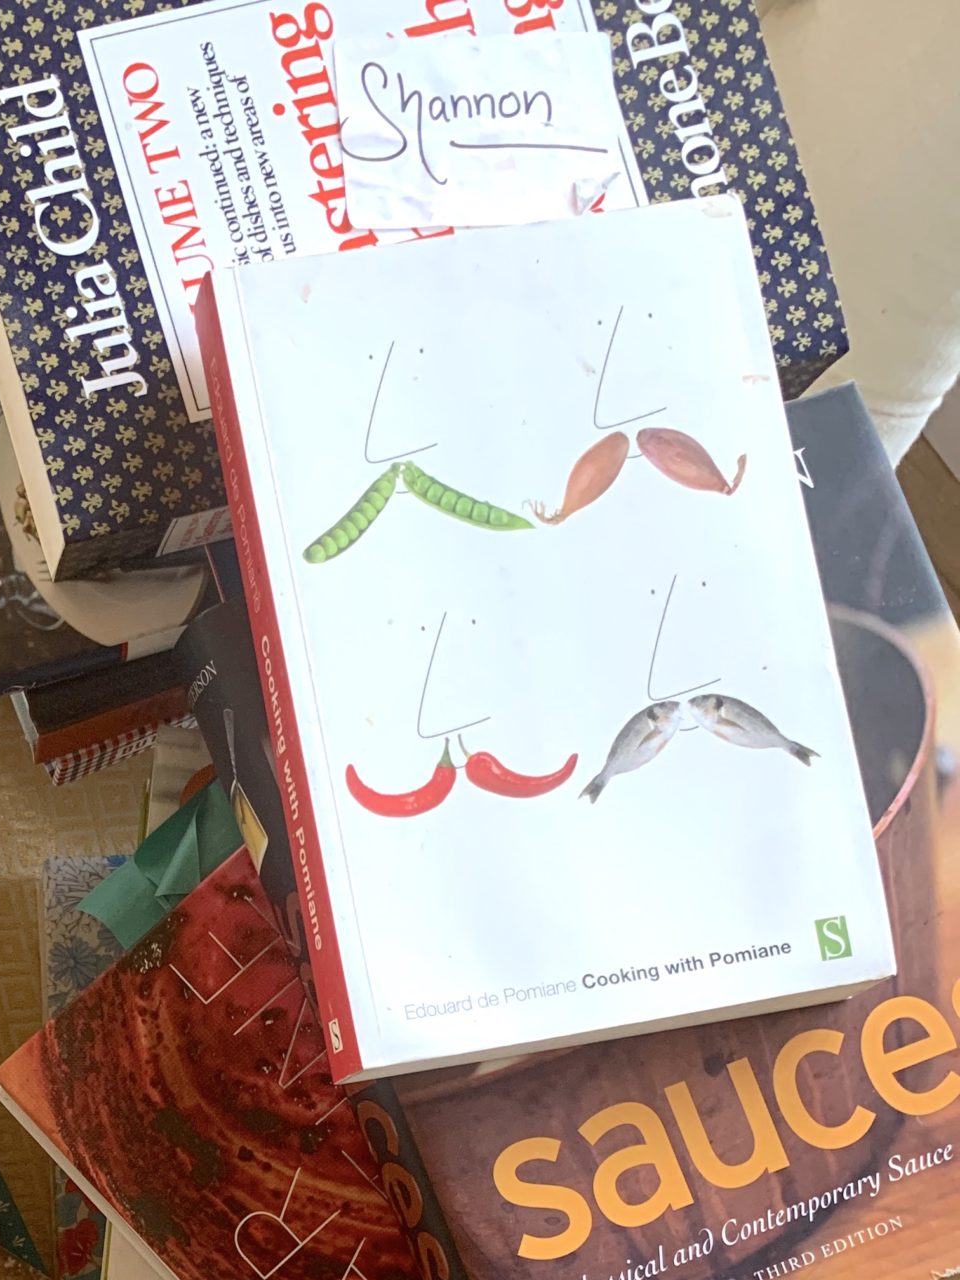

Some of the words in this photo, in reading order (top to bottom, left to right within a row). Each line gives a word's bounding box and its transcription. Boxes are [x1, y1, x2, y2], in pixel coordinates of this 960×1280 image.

[187, 86, 211, 125] new
[200, 41, 239, 146] techniques
[226, 74, 249, 94] of
[122, 62, 181, 175] TWO
[201, 126, 214, 139] a
[239, 96, 265, 148] areas
[339, 62, 553, 185] Shannon
[223, 146, 251, 181] and
[255, 149, 279, 188] new
[198, 143, 244, 243] continued:
[242, 179, 269, 243] dishes
[269, 188, 290, 232] into
[280, 231, 297, 254] us
[66, 259, 147, 398] Julia
[209, 357, 232, 463] Edouard
[229, 468, 239, 502] de
[237, 505, 262, 615] Pomiane
[261, 635, 286, 756] Cooking
[283, 761, 300, 822] with
[295, 827, 323, 952] Pomiane
[821, 917, 846, 961] S
[404, 995, 473, 1021] Edouard
[477, 991, 499, 1009] de
[503, 977, 577, 1005] Pomiane
[582, 964, 661, 991] Cooking
[664, 955, 705, 976] with
[708, 940, 792, 969] Pomiane
[673, 1227, 715, 1269] and
[720, 1168, 882, 1247] Contemporary
[888, 1141, 955, 1184] Sauce
[819, 1215, 905, 1259] EDITION
